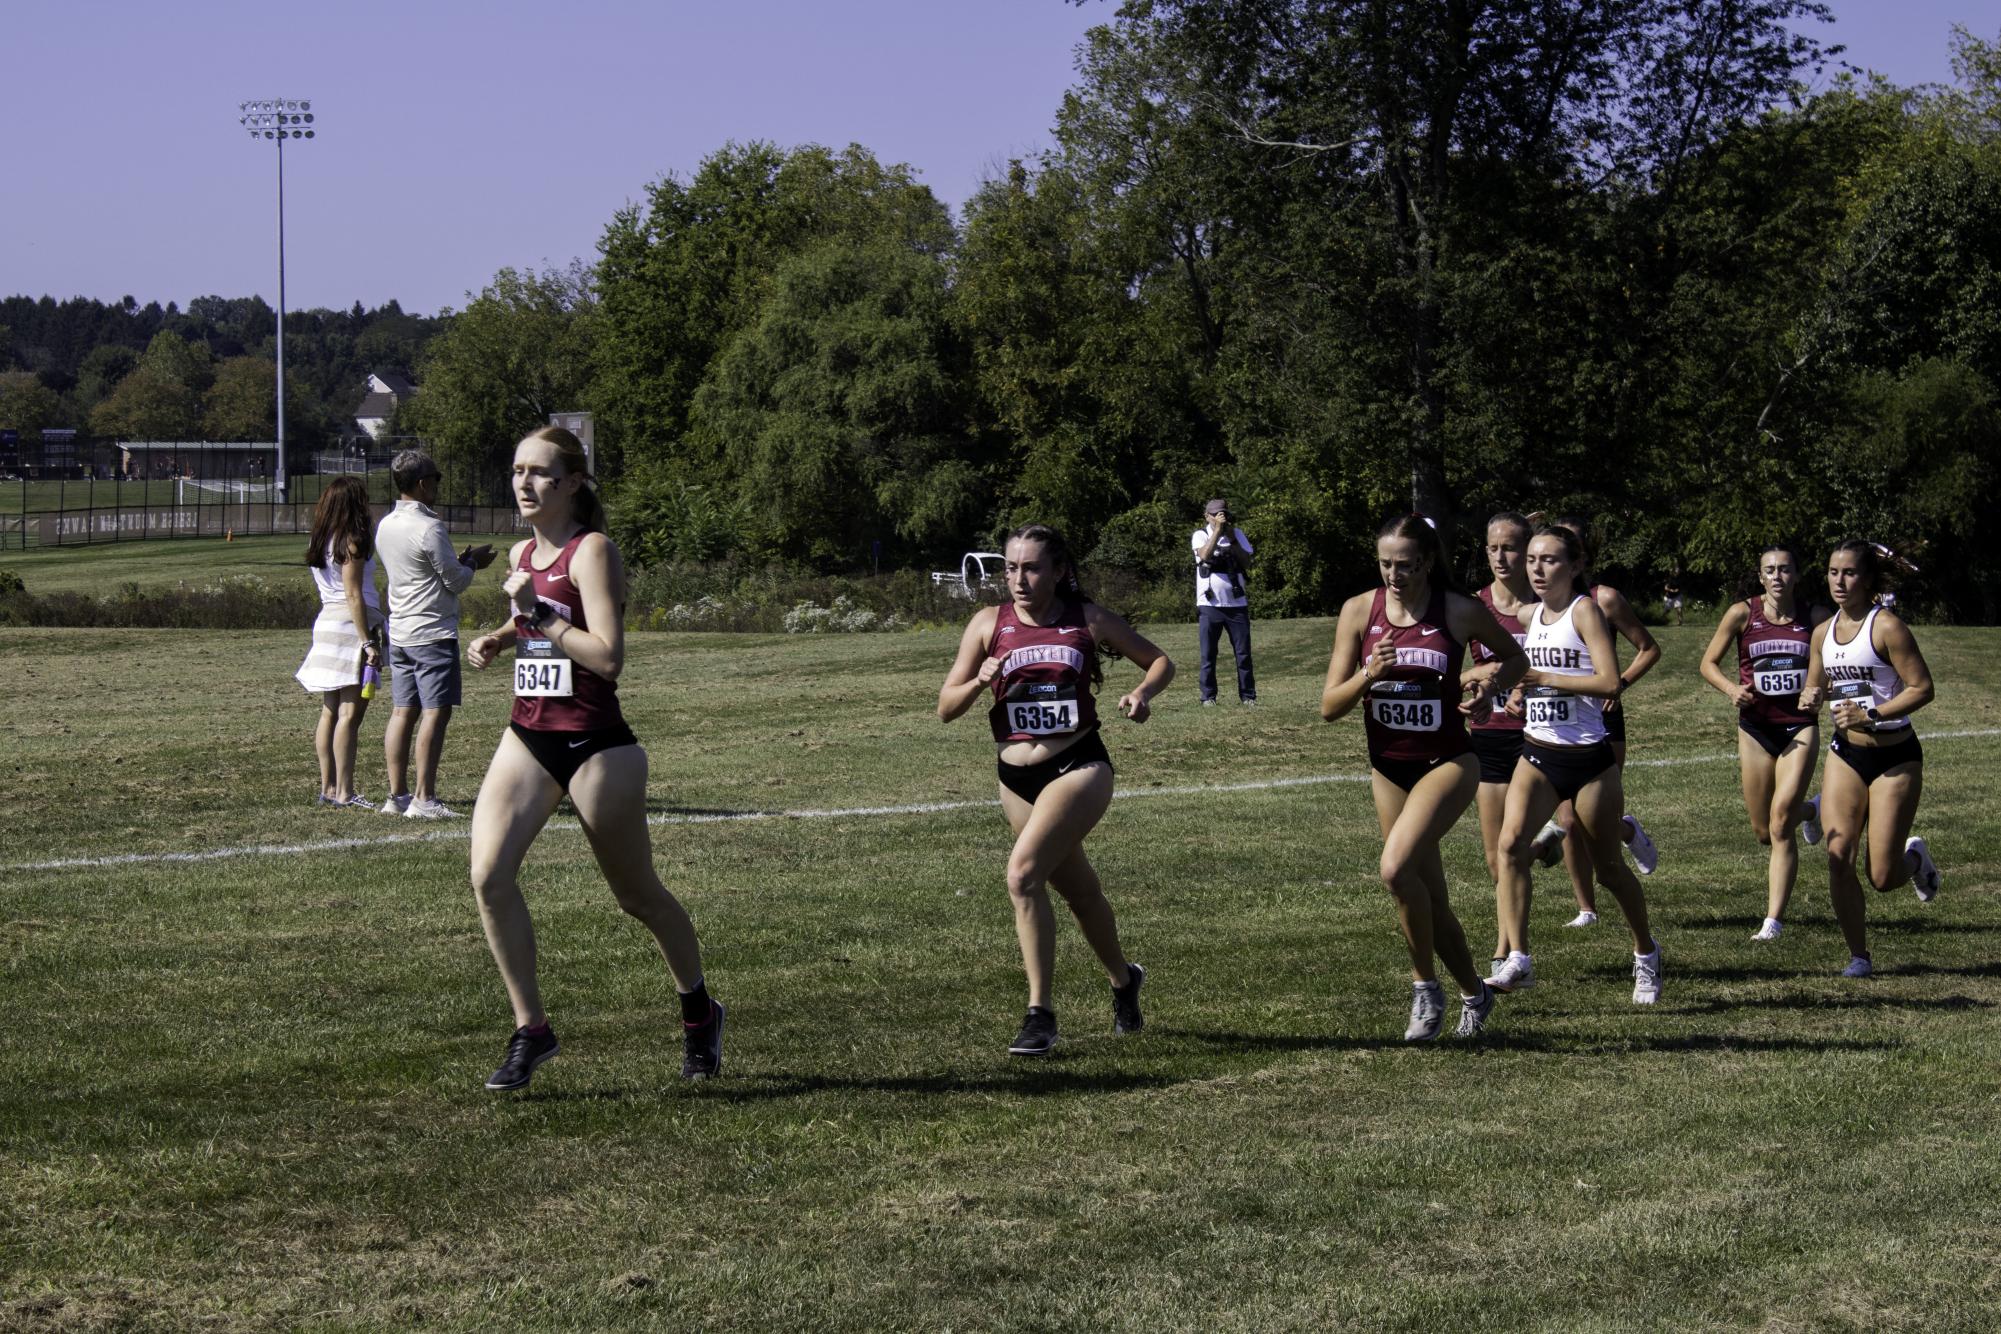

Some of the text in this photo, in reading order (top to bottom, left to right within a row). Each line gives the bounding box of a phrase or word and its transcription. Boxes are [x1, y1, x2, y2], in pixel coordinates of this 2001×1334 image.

[1525, 647, 1581, 668] HIGH
[518, 664, 561, 690] 6347
[1761, 673, 1802, 692] 6351
[1825, 665, 1876, 681] EHIGH
[1014, 705, 1071, 730] 6354
[1379, 703, 1434, 727] 6348
[1530, 700, 1569, 723] 6379
